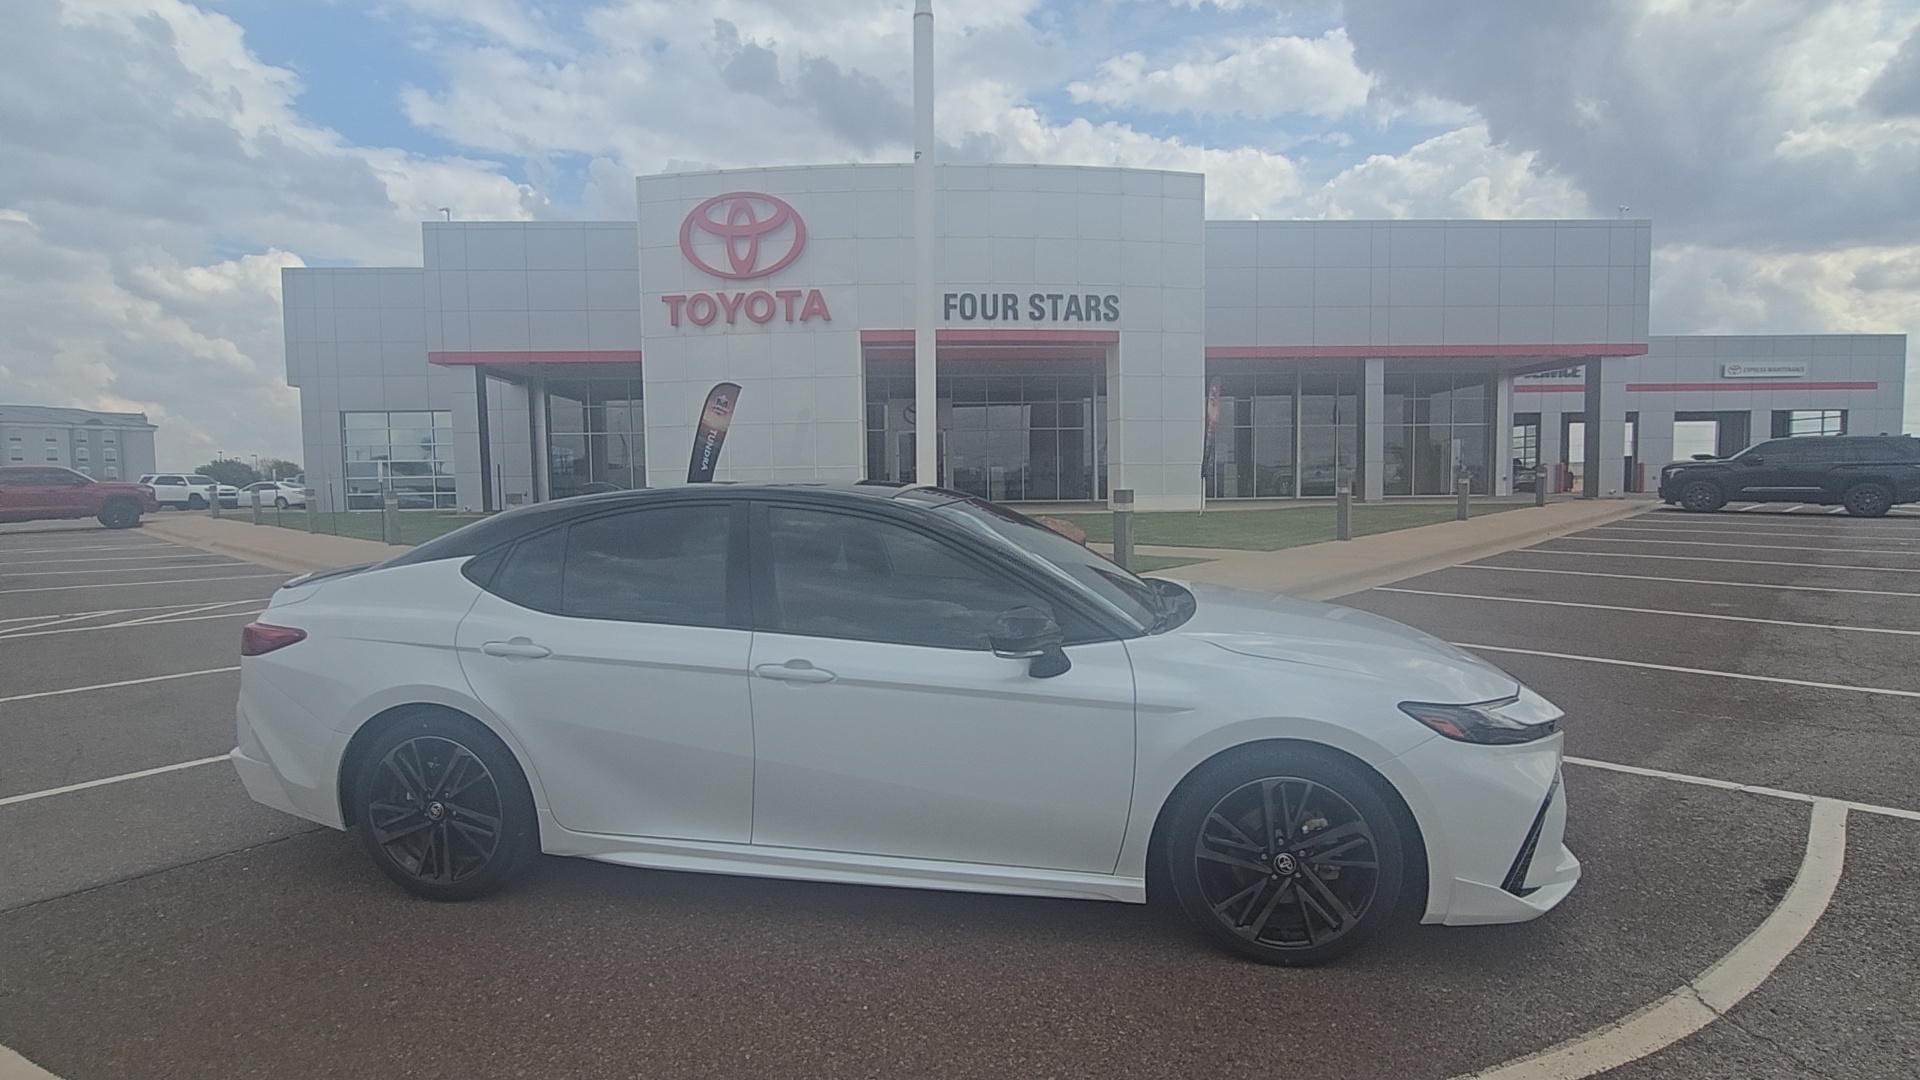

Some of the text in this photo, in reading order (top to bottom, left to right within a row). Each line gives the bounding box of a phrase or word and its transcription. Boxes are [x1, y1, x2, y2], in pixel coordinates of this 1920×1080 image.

[661, 289, 832, 326] TOYOTA
[943, 293, 1120, 322] FOUR STARS
[700, 429, 718, 471] TUNDRA
